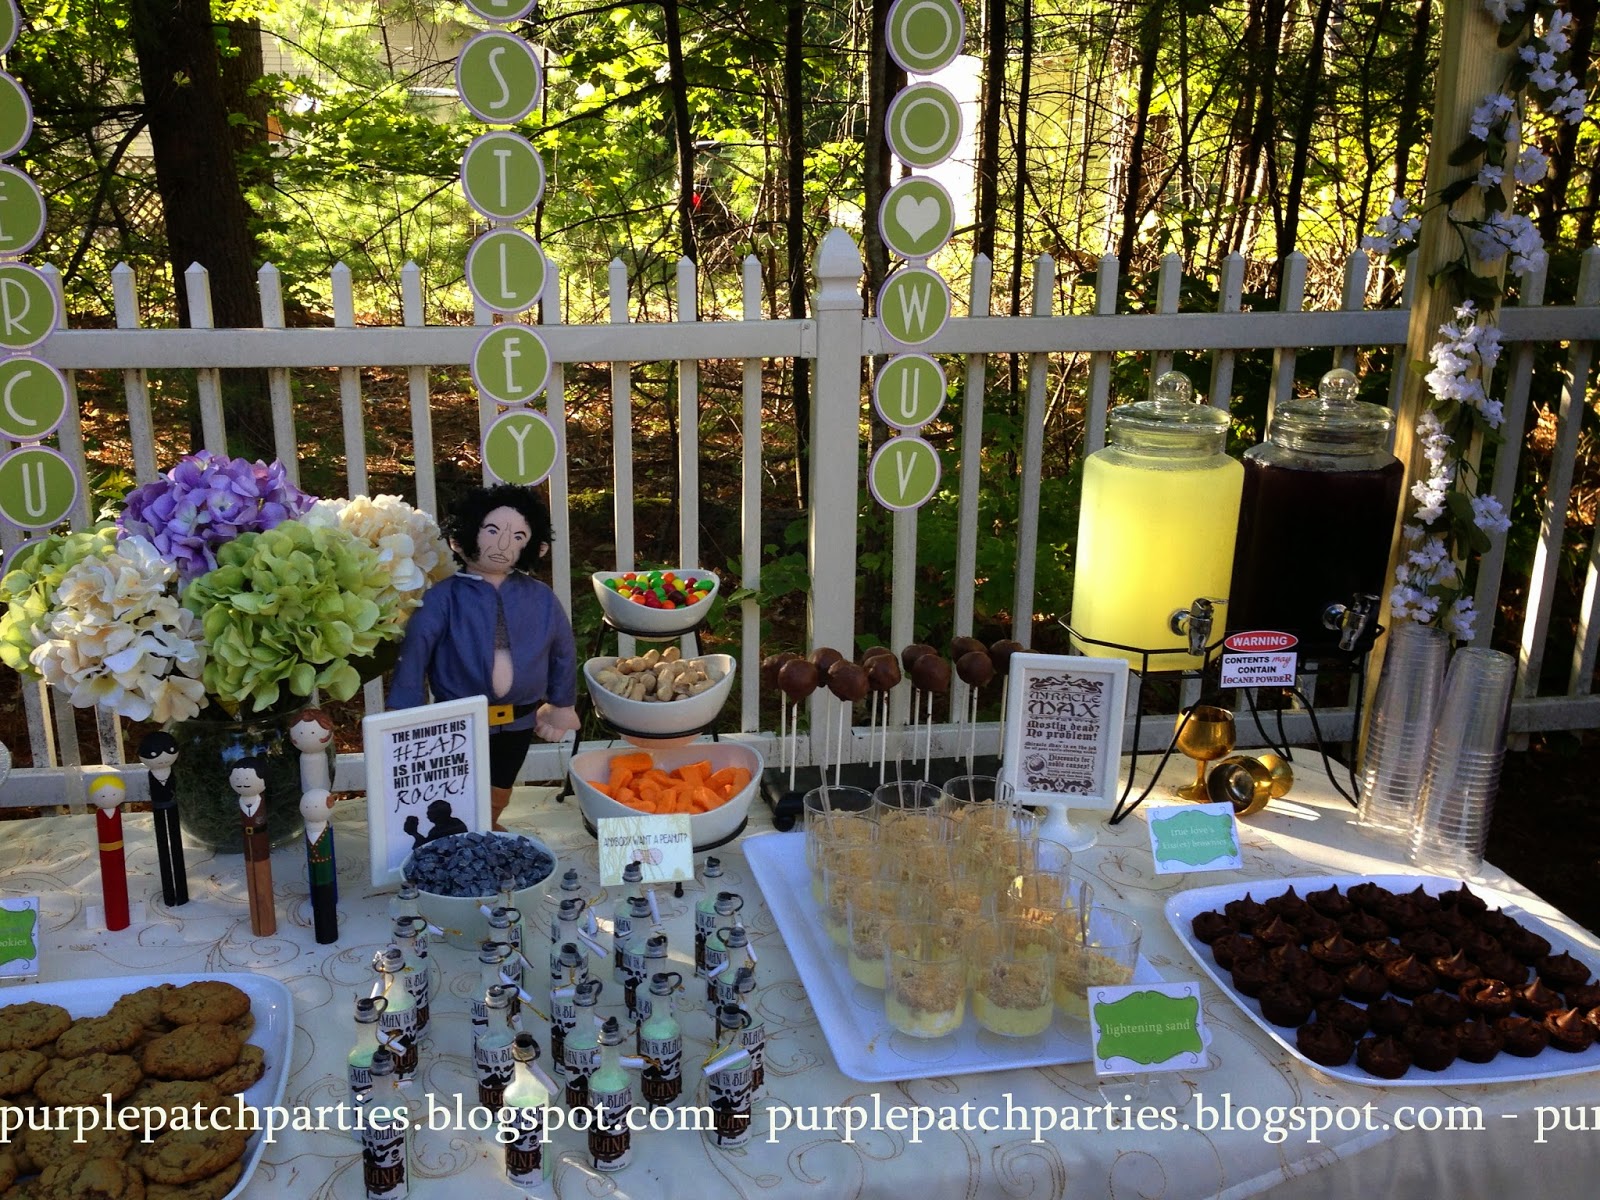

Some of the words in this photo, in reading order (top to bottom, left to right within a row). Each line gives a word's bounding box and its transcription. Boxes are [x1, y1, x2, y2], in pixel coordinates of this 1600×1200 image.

[487, 0, 533, 476] STLEY
[1232, 636, 1288, 647] WARNING
[1224, 656, 1270, 664] CONTENTS
[1271, 656, 1292, 668] may
[1237, 666, 1277, 674] CONTAIN
[1029, 690, 1101, 703] MIRACLE
[1028, 700, 1100, 718] MAX
[392, 731, 411, 744] THE
[412, 723, 448, 741] MINUTE
[450, 720, 467, 731] HIS
[1026, 720, 1067, 732] Mostly
[1069, 721, 1100, 732] dead?
[1026, 729, 1043, 739] No
[1046, 730, 1098, 741] problem!
[393, 733, 467, 763] HEAD
[393, 764, 408, 777] IS
[411, 760, 426, 773] IN
[393, 776, 410, 789] HIT
[412, 773, 422, 786] IT
[424, 767, 450, 783] WITH
[452, 763, 469, 777] THE
[394, 775, 468, 813] ROCK!
[378, 1011, 401, 1029] MAN
[1105, 1022, 1163, 1037] lightening
[1165, 1018, 1191, 1032] sand
